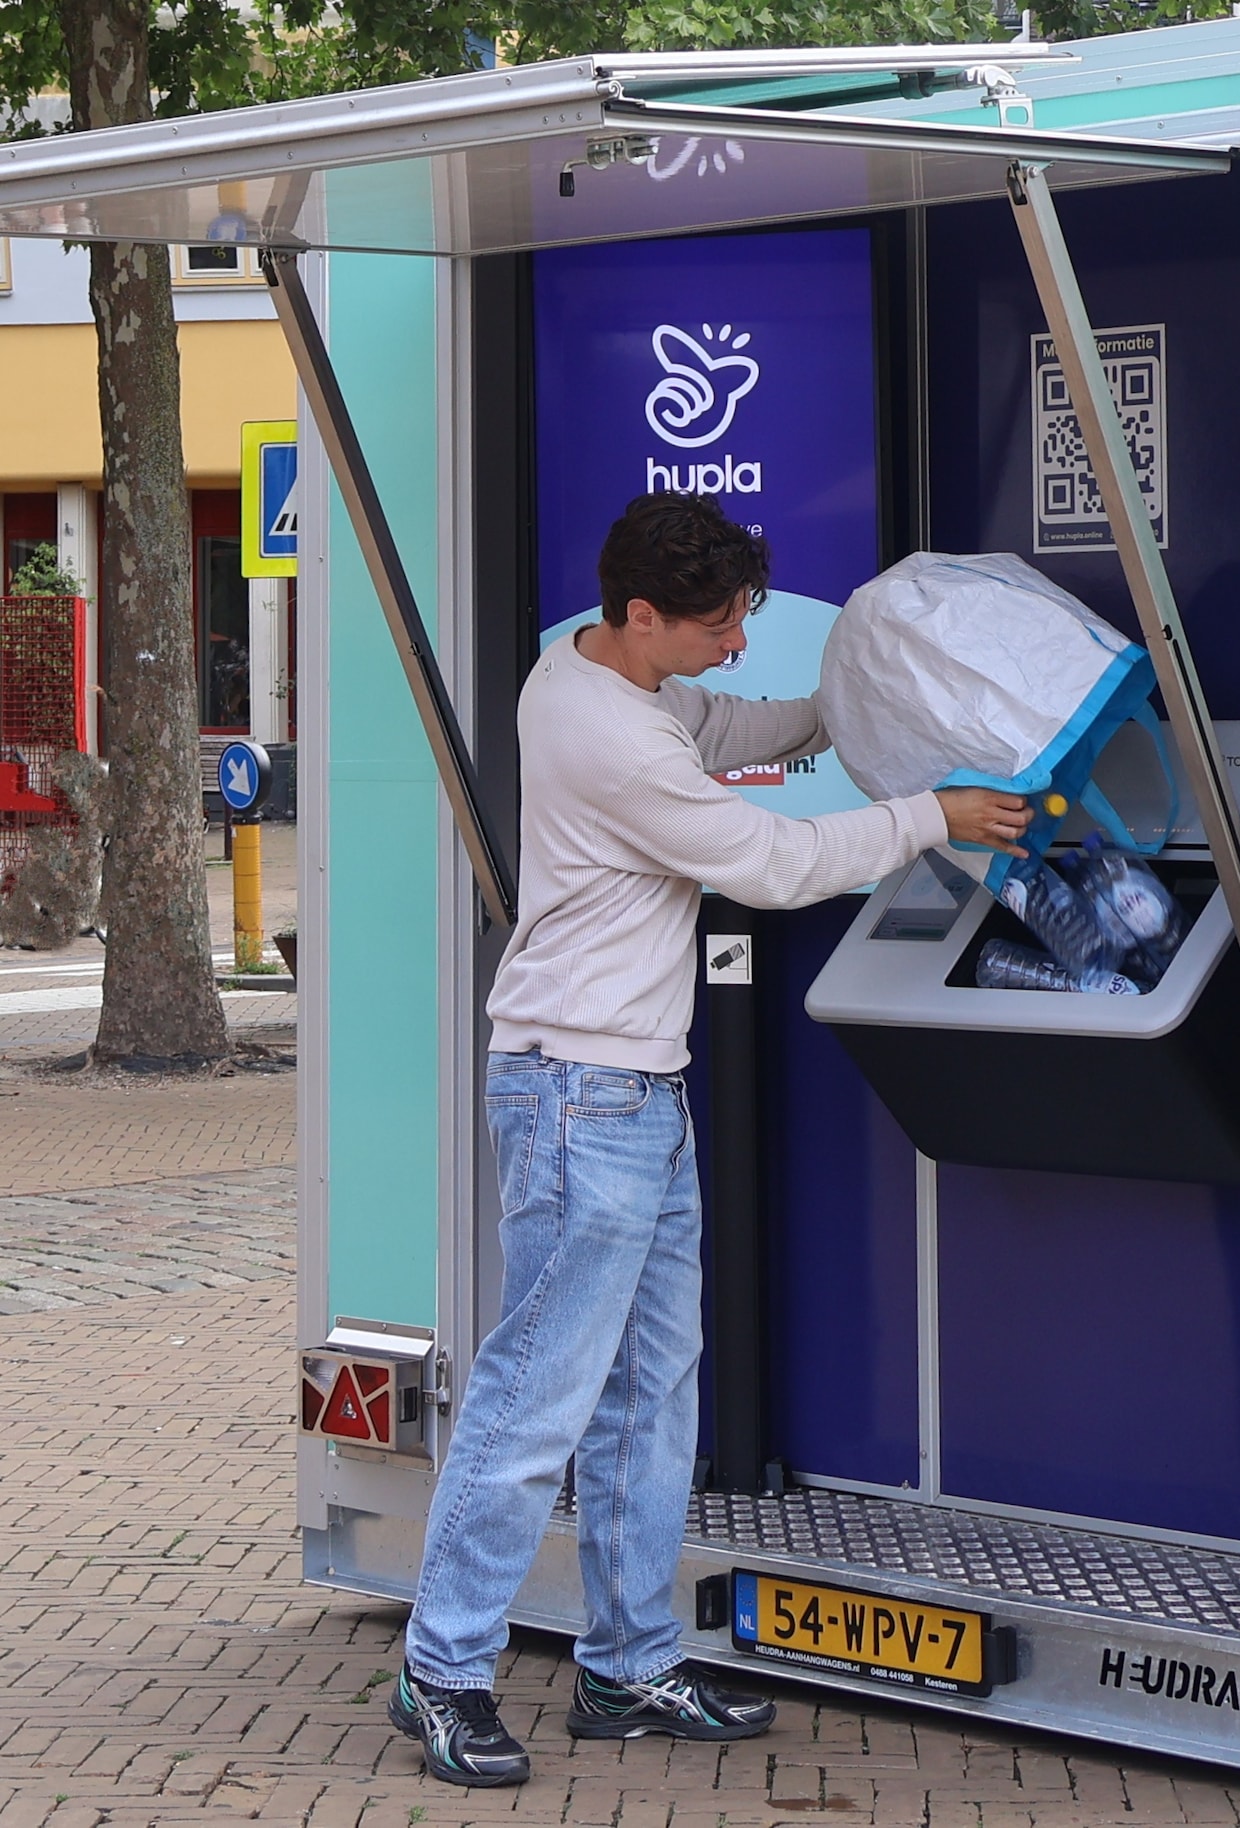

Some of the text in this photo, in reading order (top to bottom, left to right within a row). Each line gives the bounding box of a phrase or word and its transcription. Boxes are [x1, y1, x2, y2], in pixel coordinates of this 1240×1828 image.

[1094, 335, 1155, 353] ormatie
[646, 454, 761, 496] hupla
[739, 1613, 755, 1631] NL
[773, 1589, 967, 1671] 54-WPV-7
[754, 1643, 861, 1673] HEUDRA-AANHANGWAGENS.nl
[869, 1666, 888, 1678] 0488
[924, 1677, 958, 1691] Kesteren
[1099, 1648, 1240, 1712] HEUDRA
